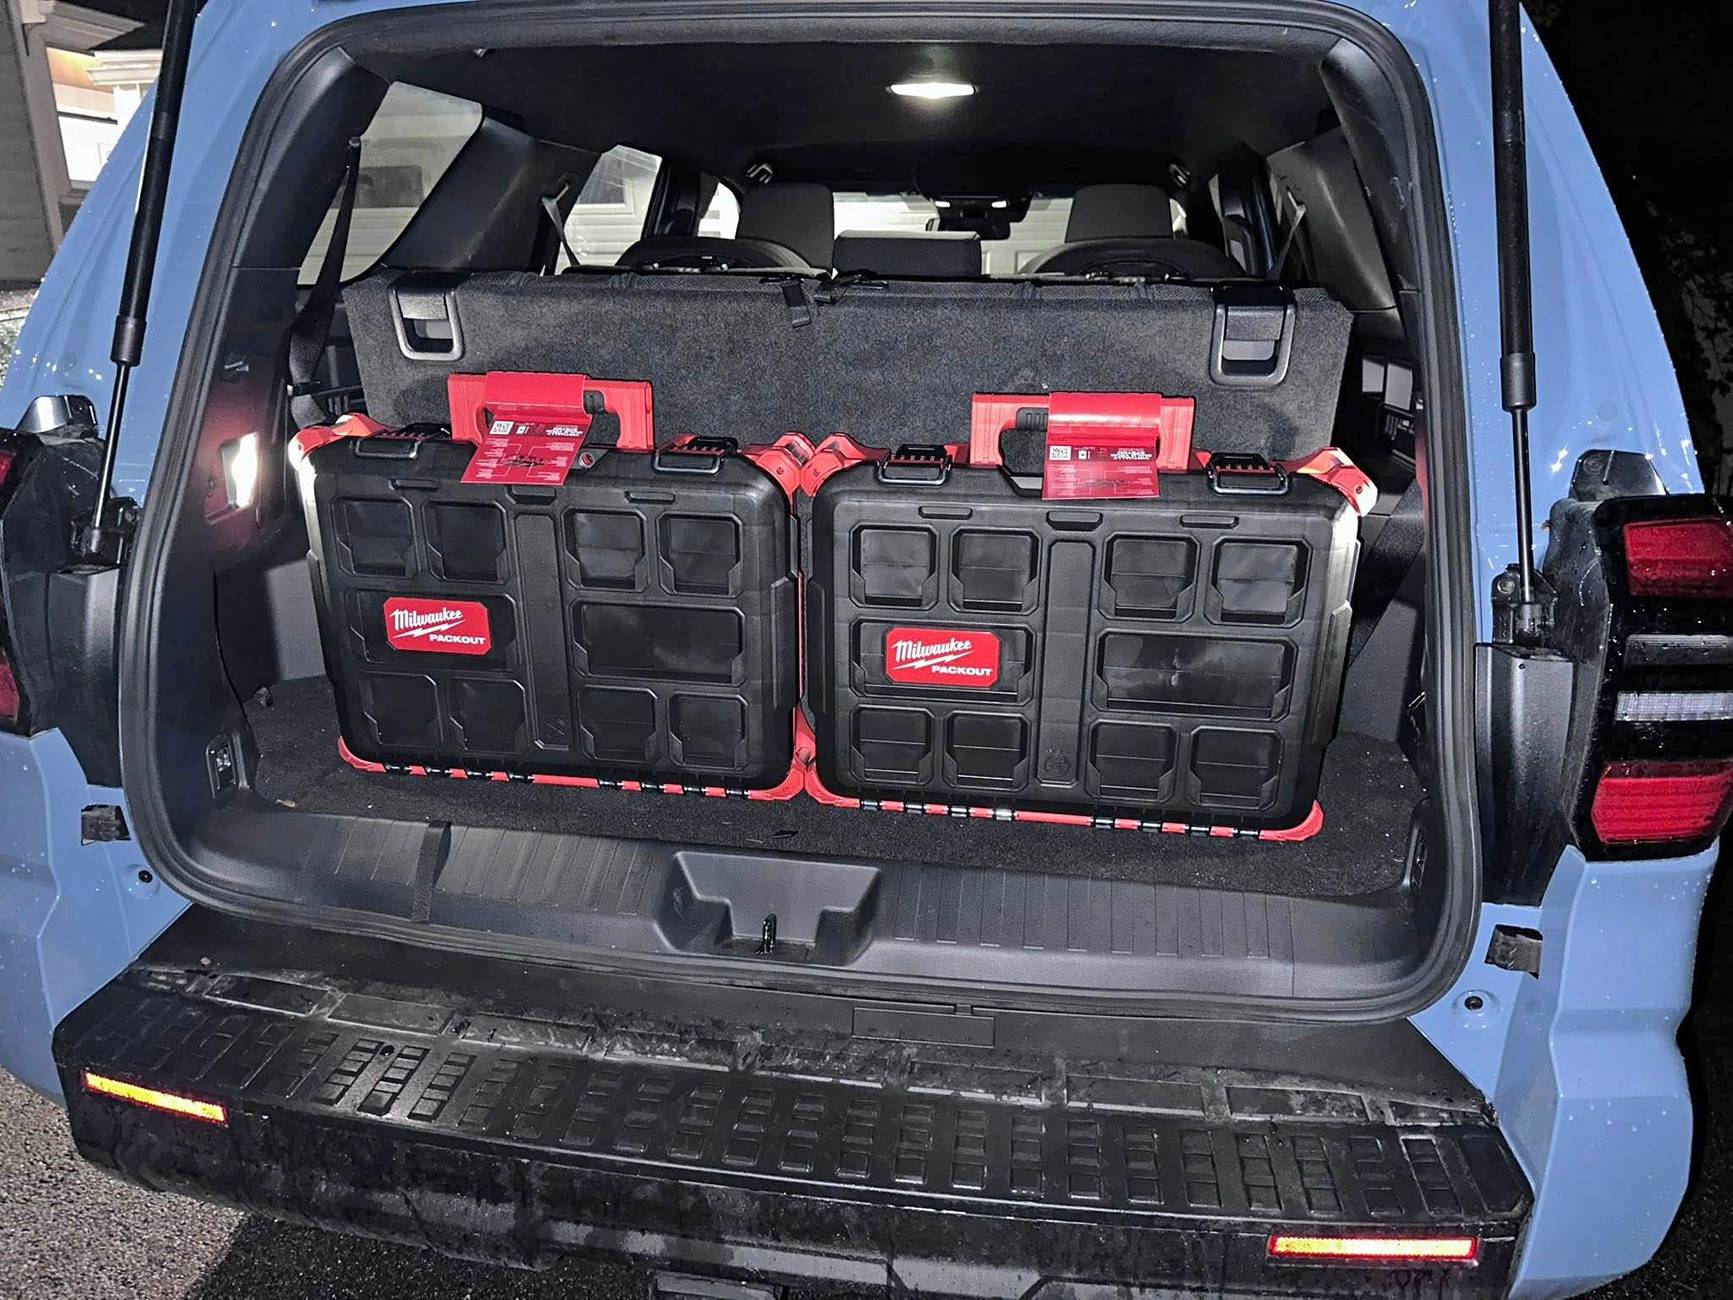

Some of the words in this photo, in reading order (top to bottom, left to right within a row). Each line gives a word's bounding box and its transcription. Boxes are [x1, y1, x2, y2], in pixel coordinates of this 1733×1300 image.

[389, 607, 463, 631] Milwaukee
[429, 633, 486, 644] PACKOUT
[891, 637, 972, 662] Milwaukee
[931, 665, 992, 676] PACKOUT
